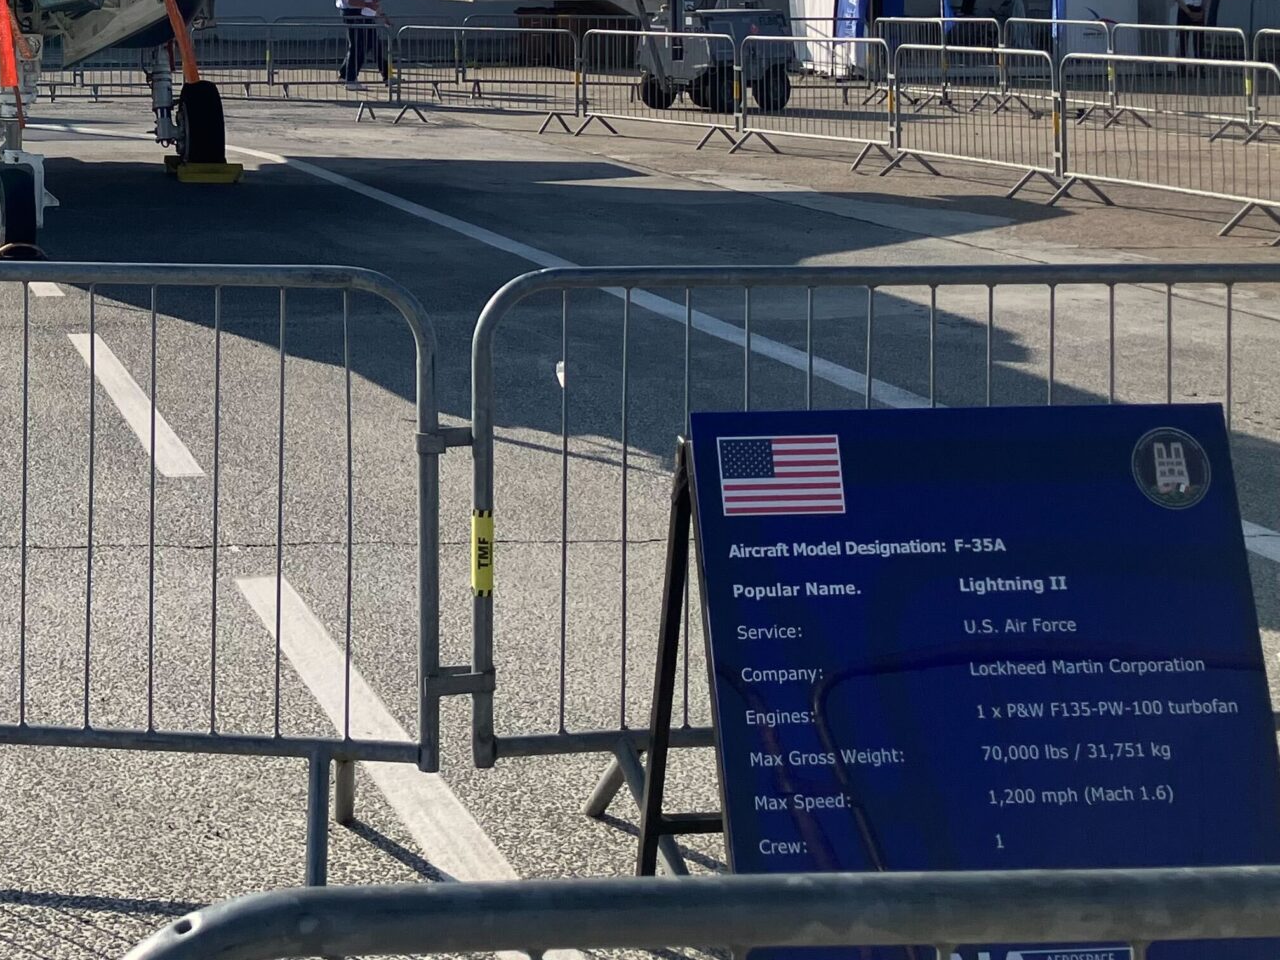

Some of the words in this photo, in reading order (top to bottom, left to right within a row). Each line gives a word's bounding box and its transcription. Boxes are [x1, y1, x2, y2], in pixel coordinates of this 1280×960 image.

[477, 536, 489, 570] TMF
[728, 541, 790, 559] Aircraft
[792, 540, 842, 557] Model
[845, 540, 947, 558] Designation:
[953, 537, 1007, 553] F-35A
[732, 582, 801, 601] Popular
[958, 575, 1045, 596] Lightning
[1048, 575, 1068, 591] II
[736, 623, 803, 640] Service:
[963, 618, 999, 634] U.S.
[1004, 618, 1028, 633] Air
[1031, 617, 1077, 633] Force
[741, 667, 824, 684] Company:
[969, 659, 1047, 676] Lockheed
[1051, 659, 1104, 675] Martin
[1108, 657, 1206, 676] Corporation
[745, 709, 816, 727] Engines:
[976, 704, 986, 719] 1
[991, 706, 1002, 719] x
[1006, 702, 1044, 718] P&W
[1050, 699, 1163, 717] F135-PW-100
[1167, 698, 1239, 715] turbofan
[749, 751, 784, 767] Max
[788, 750, 837, 766] Gross
[840, 748, 906, 767] Weight:
[981, 744, 1040, 764] 70,000
[1044, 743, 1070, 760] lbs
[1074, 743, 1081, 761] /
[1087, 742, 1145, 761] 31,751
[1150, 741, 1171, 761] kg
[754, 795, 788, 811] Max
[793, 793, 852, 812] Speed:
[988, 788, 1036, 808] 1,200
[1041, 787, 1078, 806] mph
[1084, 785, 1135, 806] (Mach
[1139, 784, 1174, 804] 1.6)
[758, 838, 809, 855] Crew:
[995, 833, 1005, 849] 1
